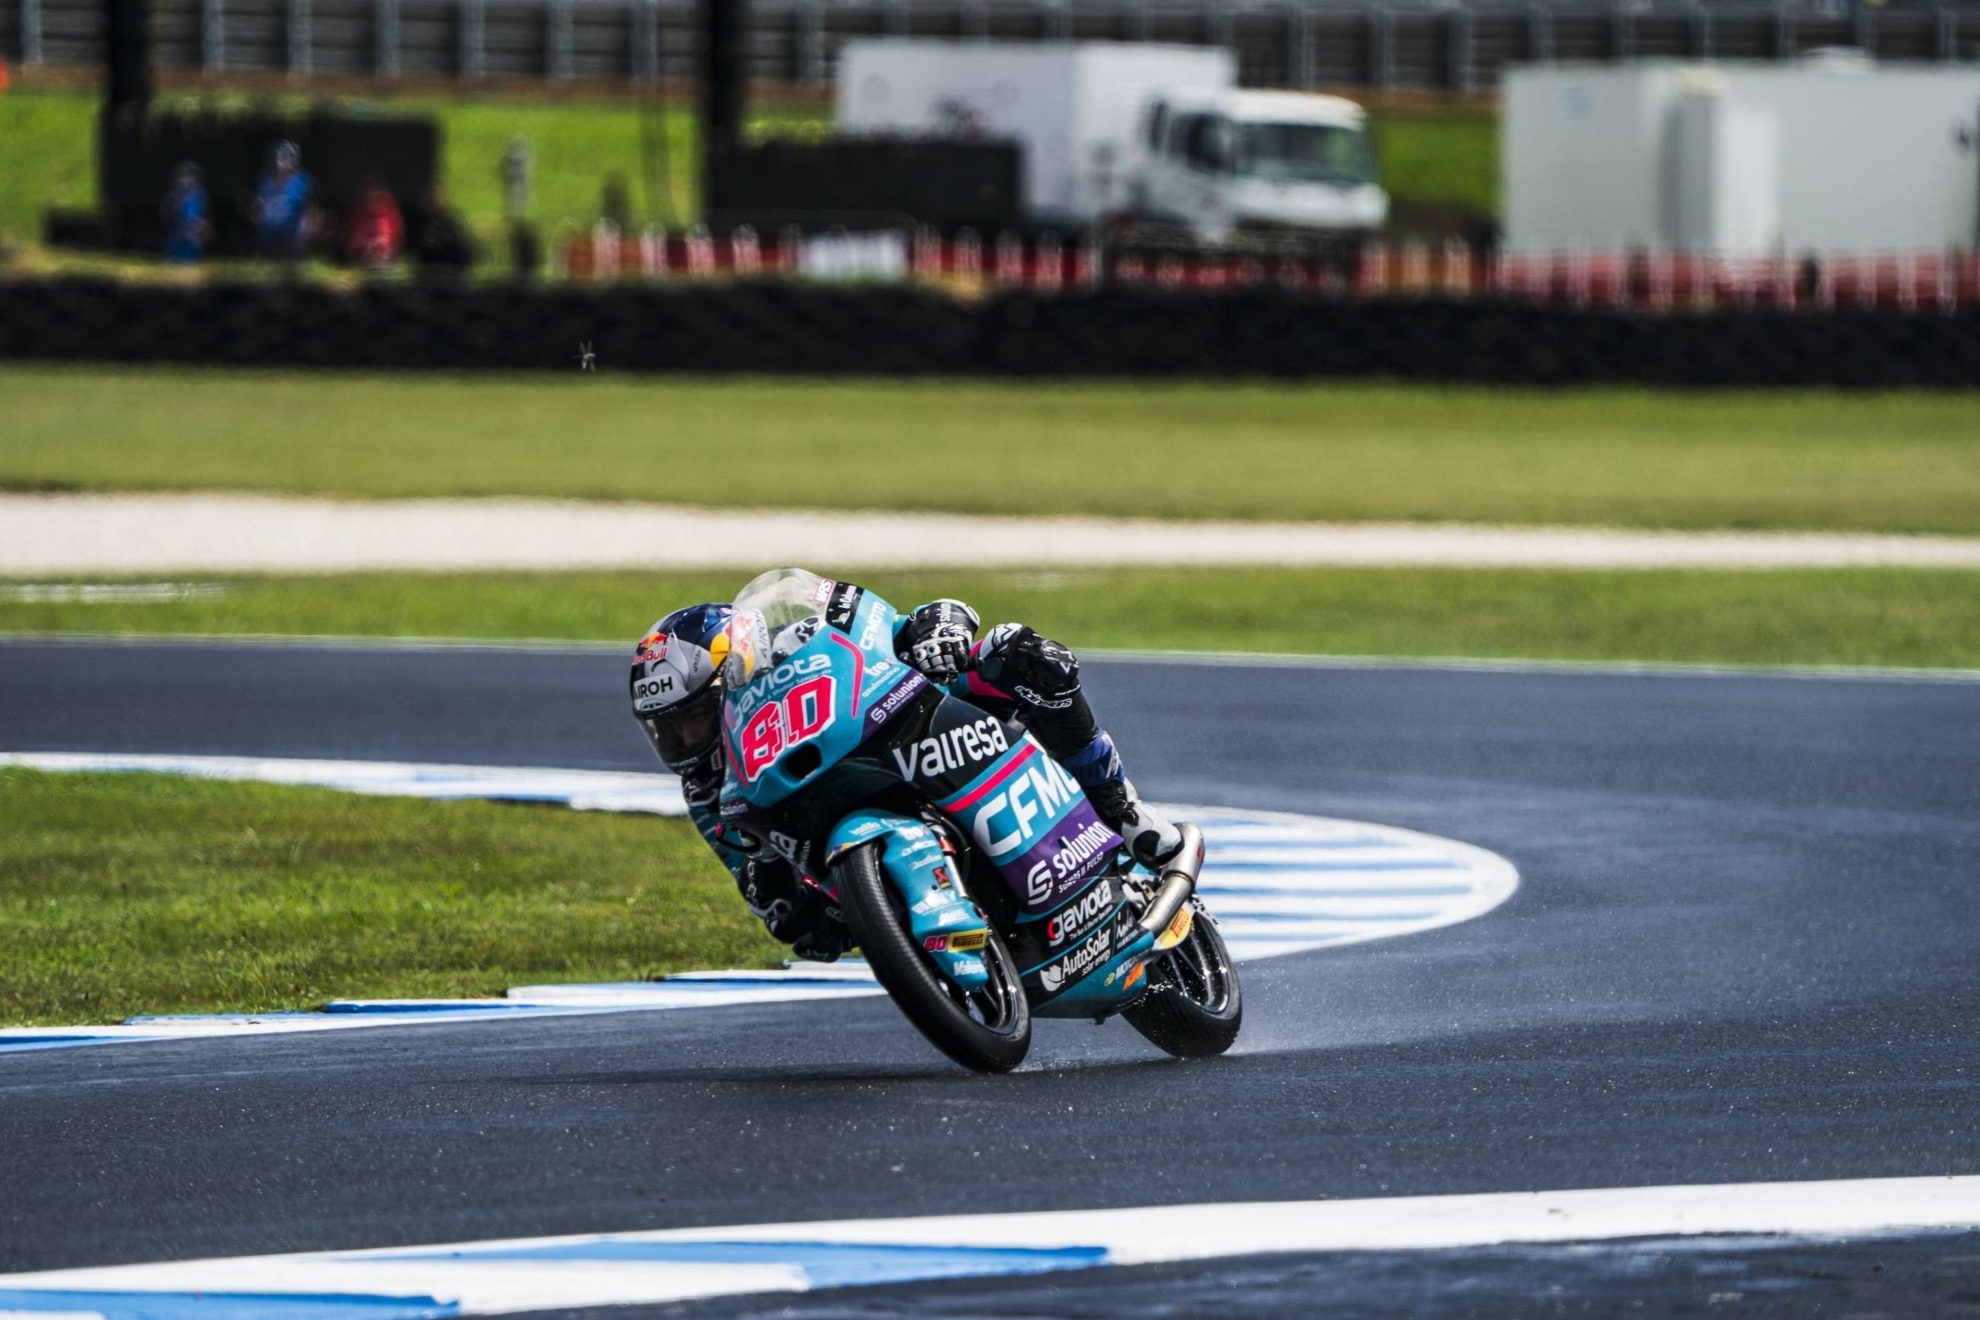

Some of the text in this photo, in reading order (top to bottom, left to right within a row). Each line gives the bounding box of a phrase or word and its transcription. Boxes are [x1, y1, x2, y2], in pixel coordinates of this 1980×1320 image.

[859, 601, 887, 650] CFMOTO
[882, 675, 924, 711] solunion
[741, 674, 837, 783] 80
[1052, 821, 1115, 879] solunion
[1047, 879, 1112, 947] gaviota
[924, 934, 948, 952] 80
[952, 933, 984, 948] PIRELLI
[1062, 929, 1111, 979] AutoSolar
